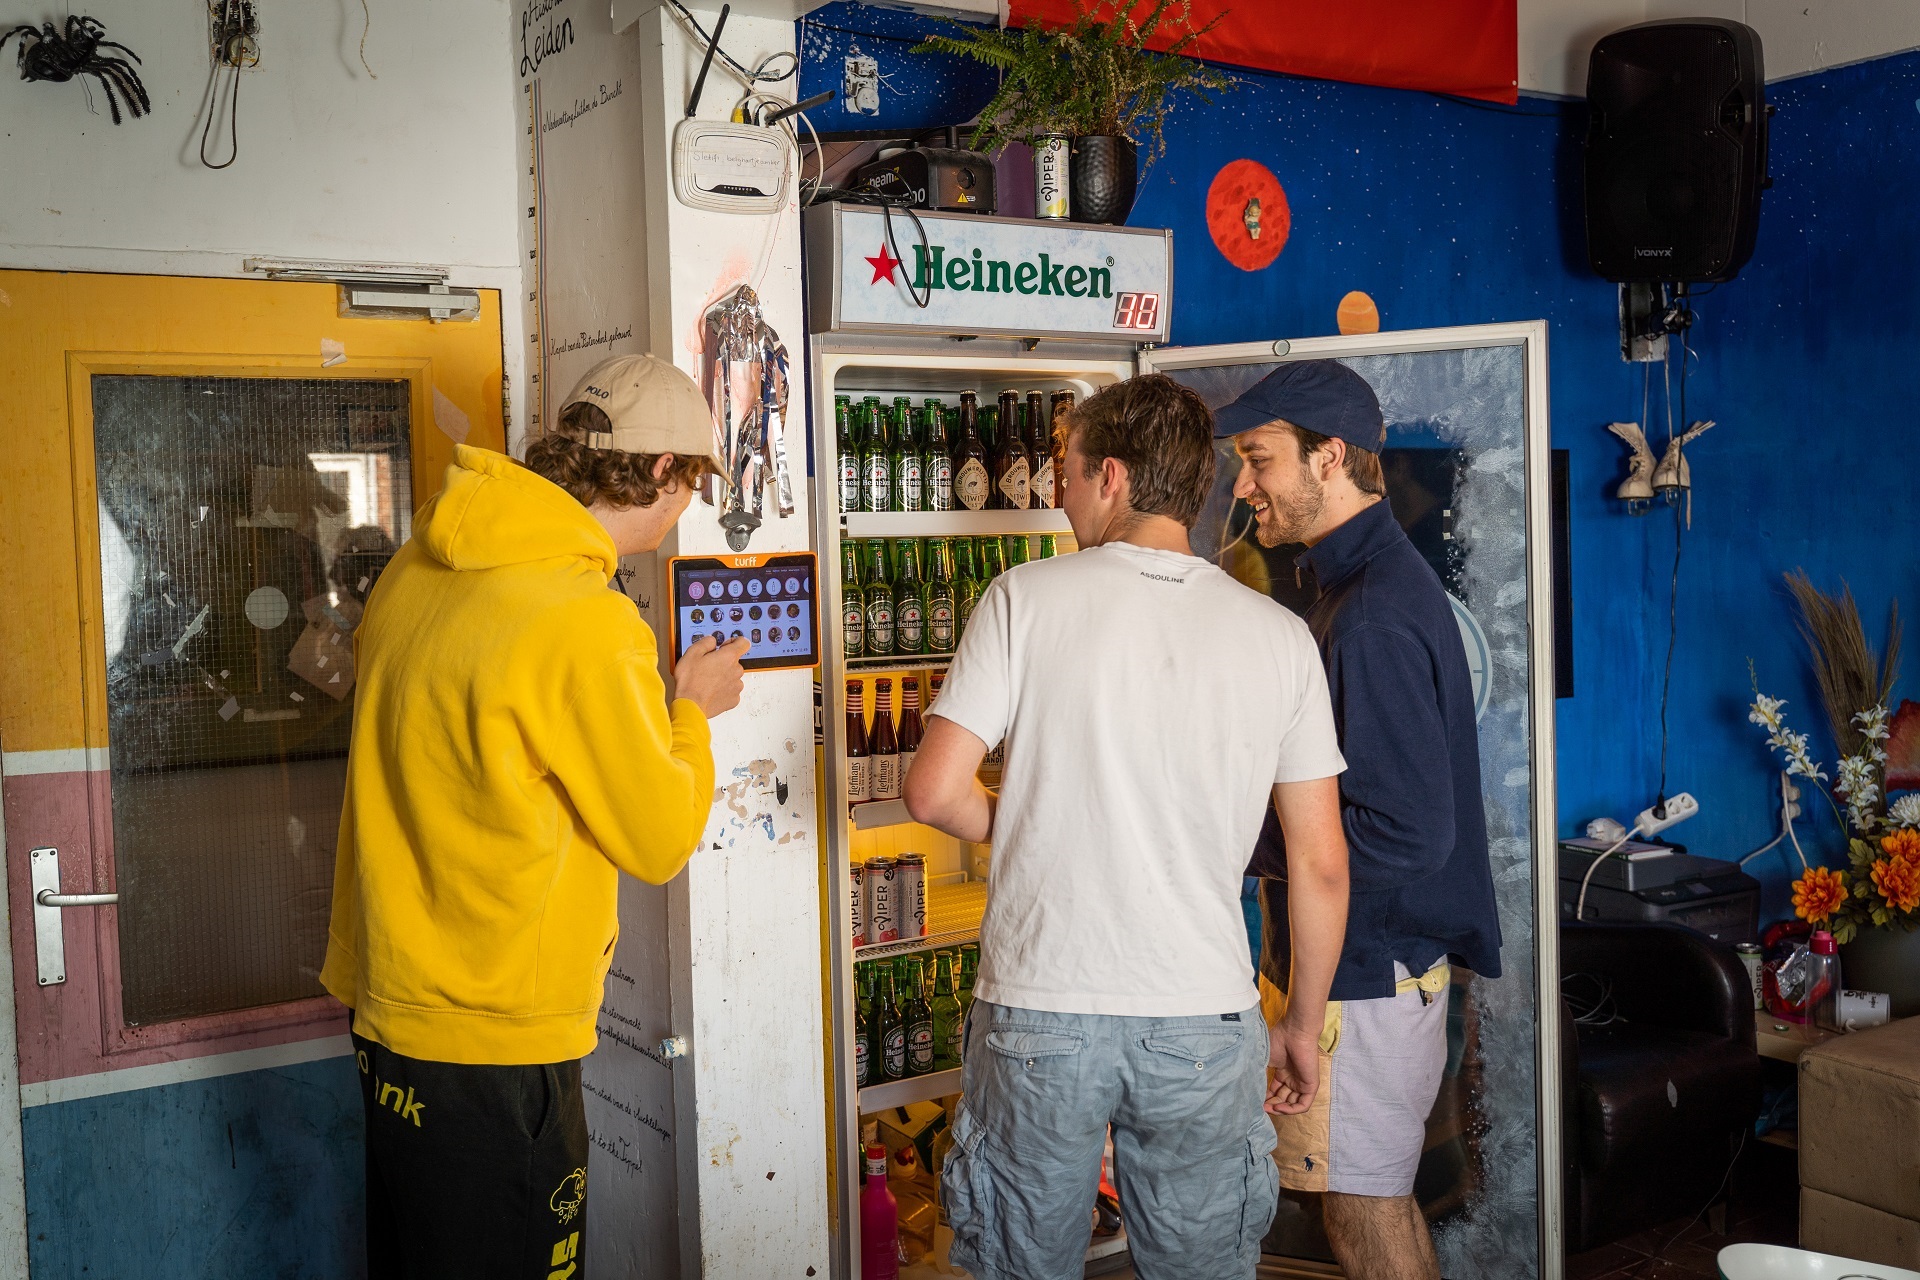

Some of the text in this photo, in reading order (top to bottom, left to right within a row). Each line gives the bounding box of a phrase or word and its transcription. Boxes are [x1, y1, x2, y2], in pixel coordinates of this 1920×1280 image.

[520, 10, 575, 78] Leiden
[1041, 155, 1059, 202] VIPER
[1637, 249, 1672, 257] VONYX
[585, 385, 610, 400] POLO
[734, 557, 757, 567] turff
[1140, 571, 1185, 584] ASSOULINE
[848, 762, 860, 796] Liefmans
[877, 759, 890, 793] Liefmans
[873, 886, 892, 931] VIPER
[914, 880, 928, 925] VIPER
